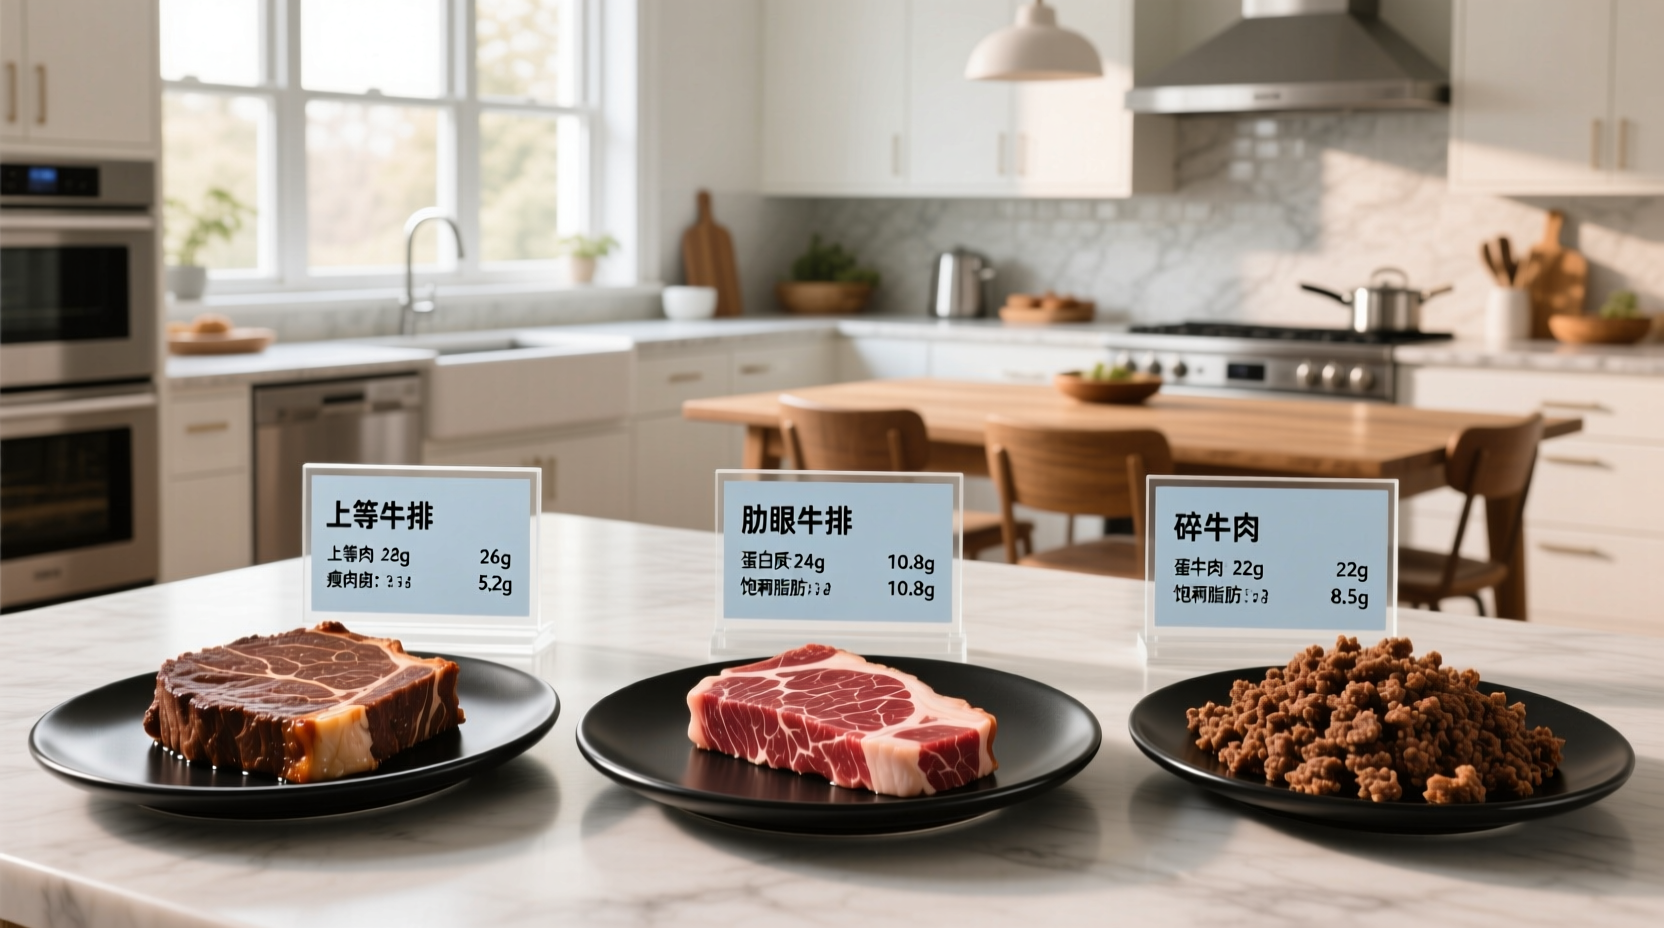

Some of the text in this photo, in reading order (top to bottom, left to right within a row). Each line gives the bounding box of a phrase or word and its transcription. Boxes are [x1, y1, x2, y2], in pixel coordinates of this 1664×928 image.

[326, 499, 434, 531] 上等牛排
[741, 504, 853, 536] 肋眼牛排
[1173, 511, 1259, 544] 碎牛肉
[327, 544, 374, 564] 上等肉
[479, 548, 511, 570] 26g
[793, 553, 825, 574] 24g
[888, 553, 935, 575] 10.8g
[1233, 560, 1264, 581] 22g
[1337, 561, 1369, 583] 22g
[888, 580, 935, 602] 10.8g
[1331, 588, 1369, 611] 8.5g
